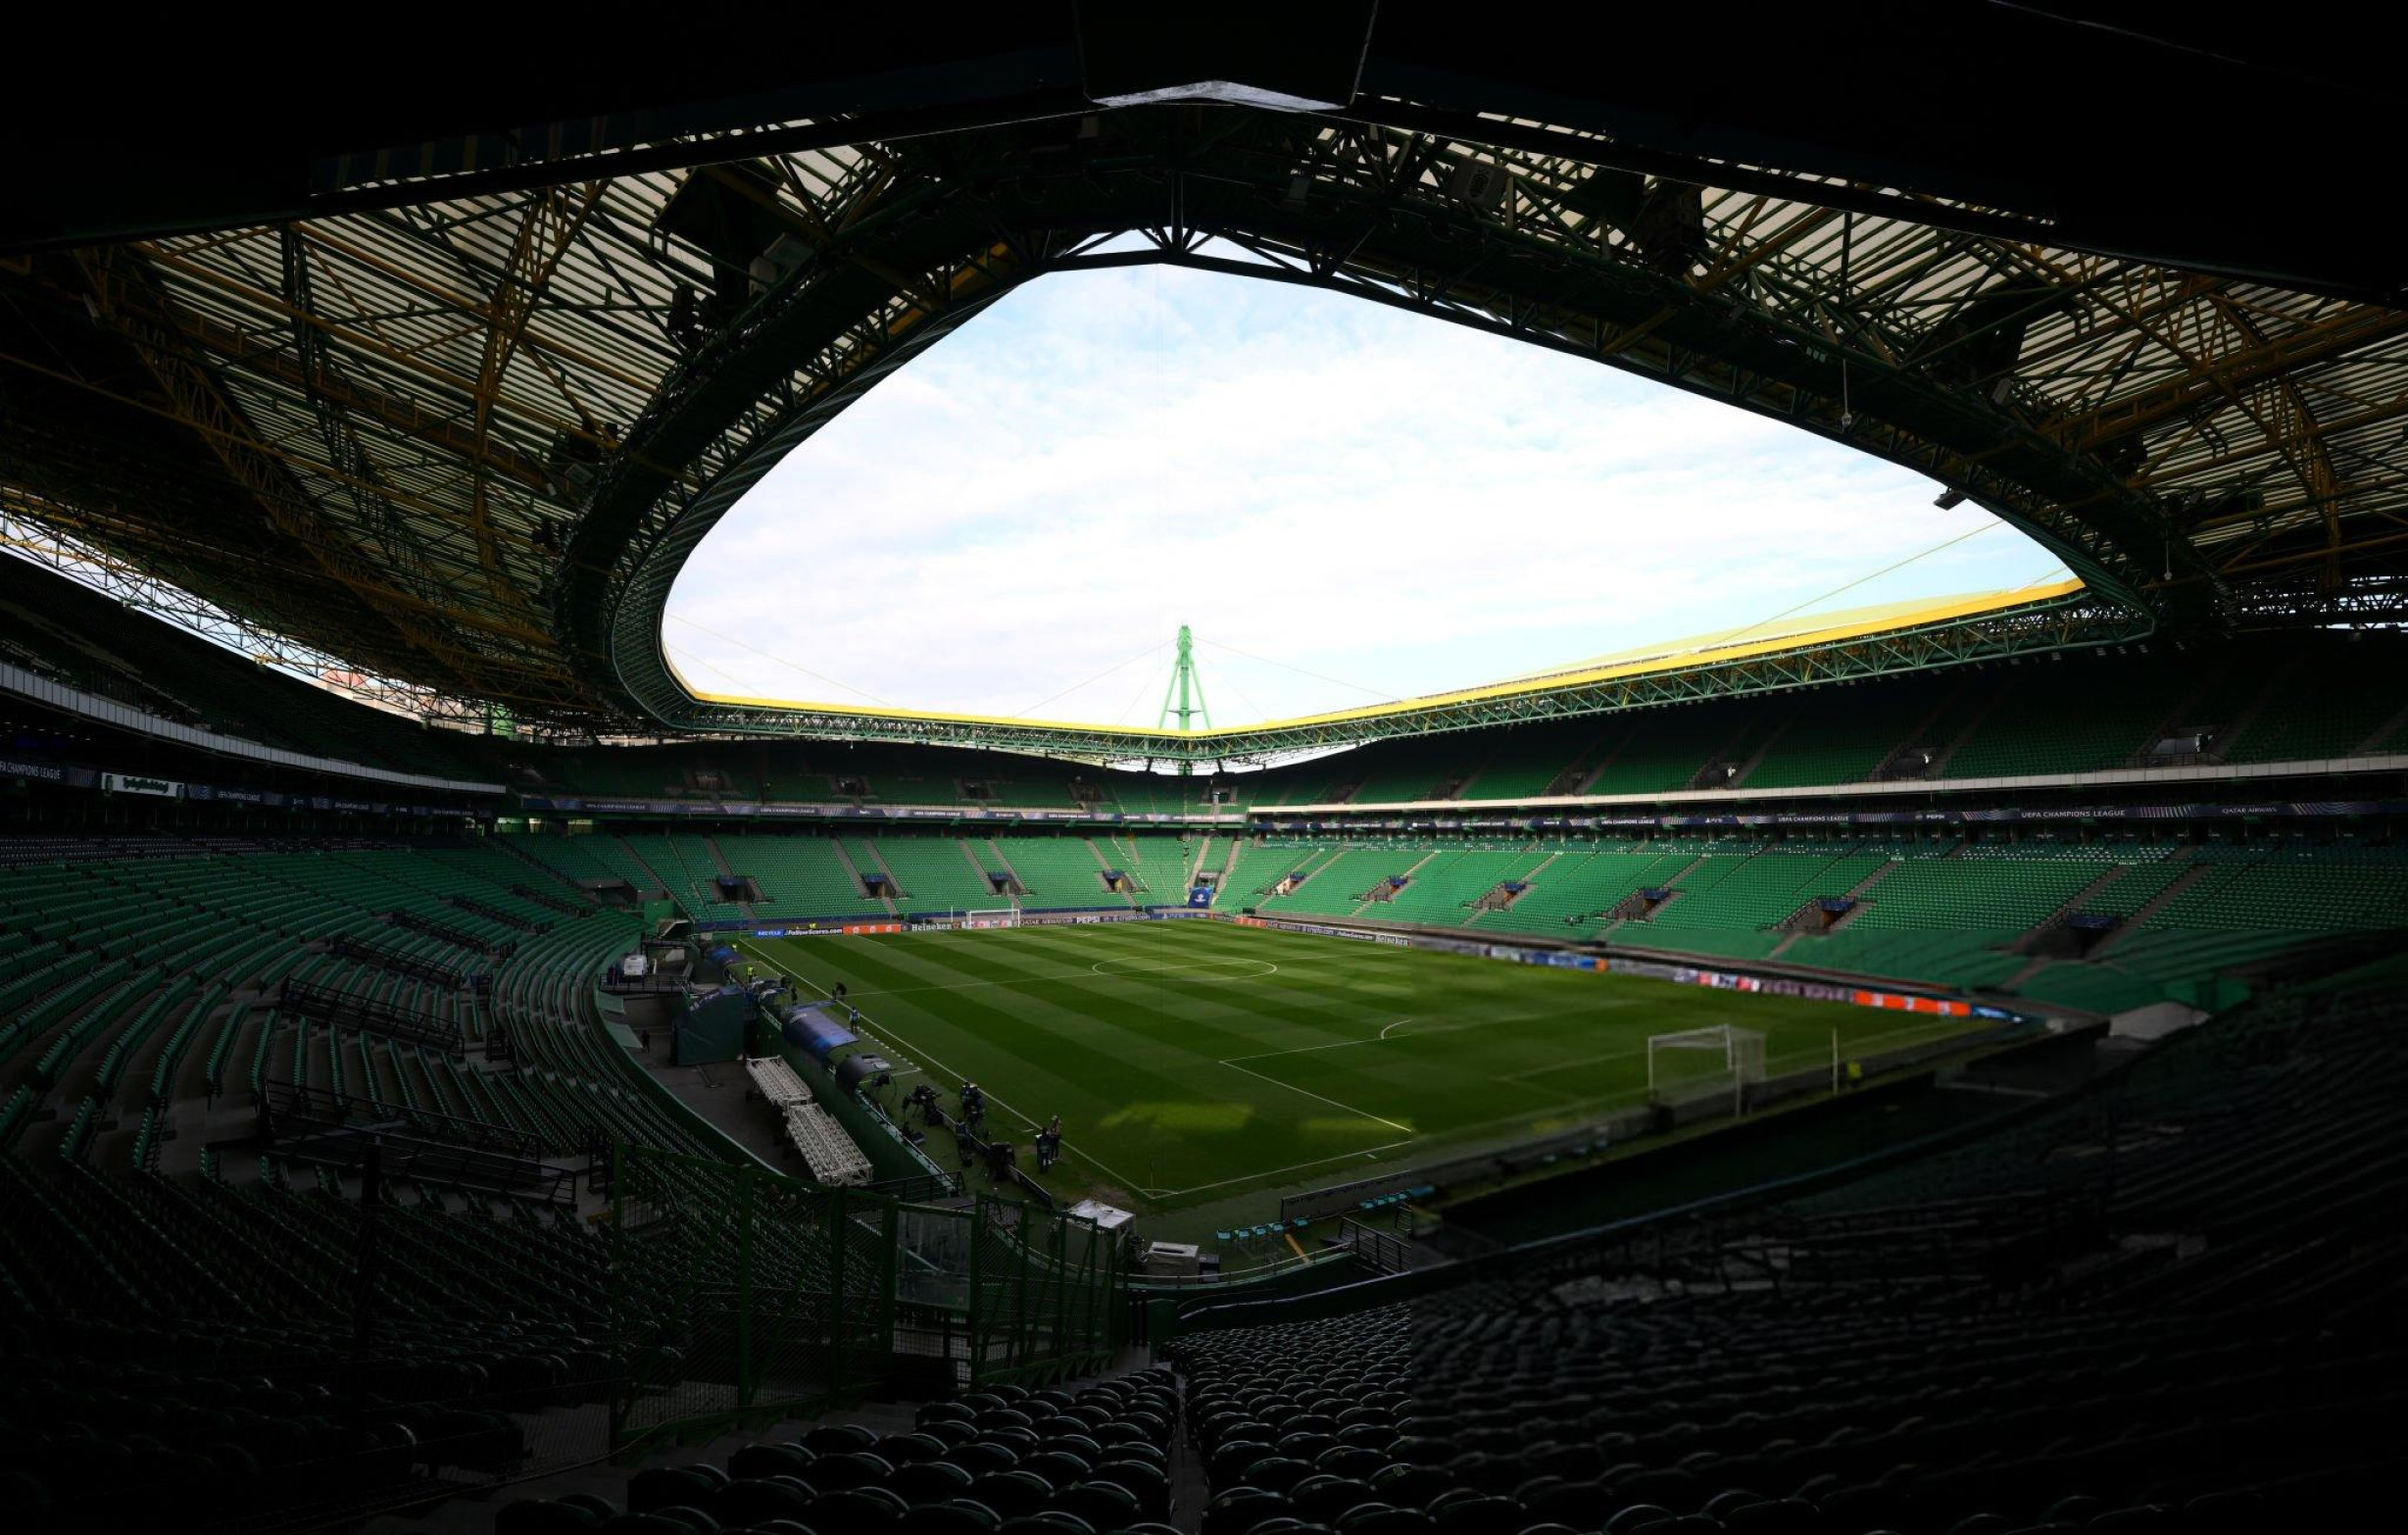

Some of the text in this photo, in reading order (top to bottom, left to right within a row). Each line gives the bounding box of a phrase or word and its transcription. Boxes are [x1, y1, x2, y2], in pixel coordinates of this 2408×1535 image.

[2043, 810, 2090, 818] CHAMPIONS
[2093, 809, 2126, 817] LEAGUE
[2221, 806, 2278, 816] QATAR AIRWAYS
